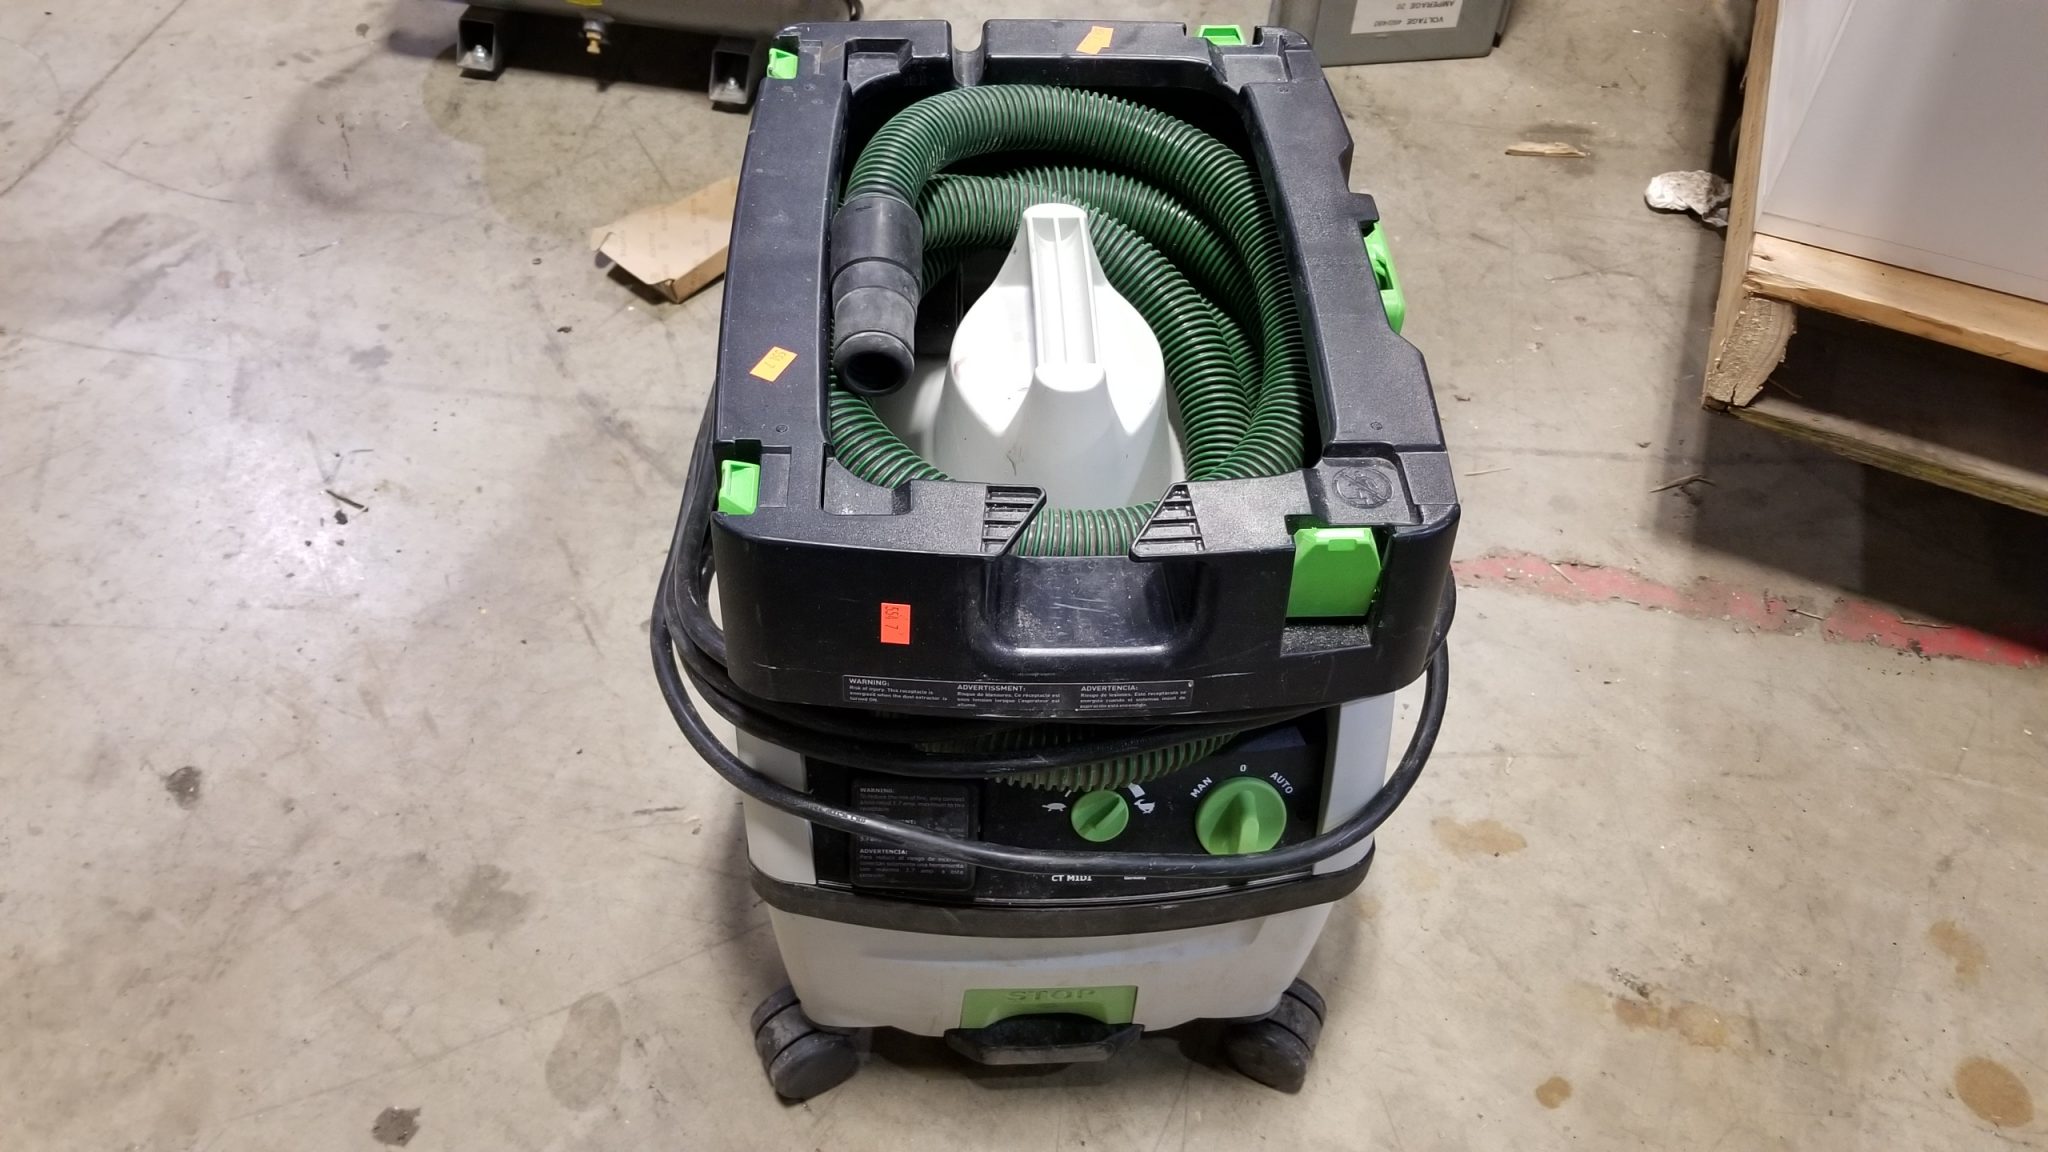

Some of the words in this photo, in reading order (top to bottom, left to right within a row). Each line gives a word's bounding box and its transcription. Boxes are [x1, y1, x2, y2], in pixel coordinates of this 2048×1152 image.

[1409, 1, 1455, 10] AMPERAGE
[1406, 16, 1443, 25] VOLTAGE
[849, 678, 890, 687] WARNING:
[1080, 684, 1138, 692] ADVERTENCIA:
[1190, 777, 1213, 798] MAN
[1269, 772, 1294, 794] AUTO
[1051, 874, 1065, 882] CT
[1007, 989, 1097, 1001] STOP
